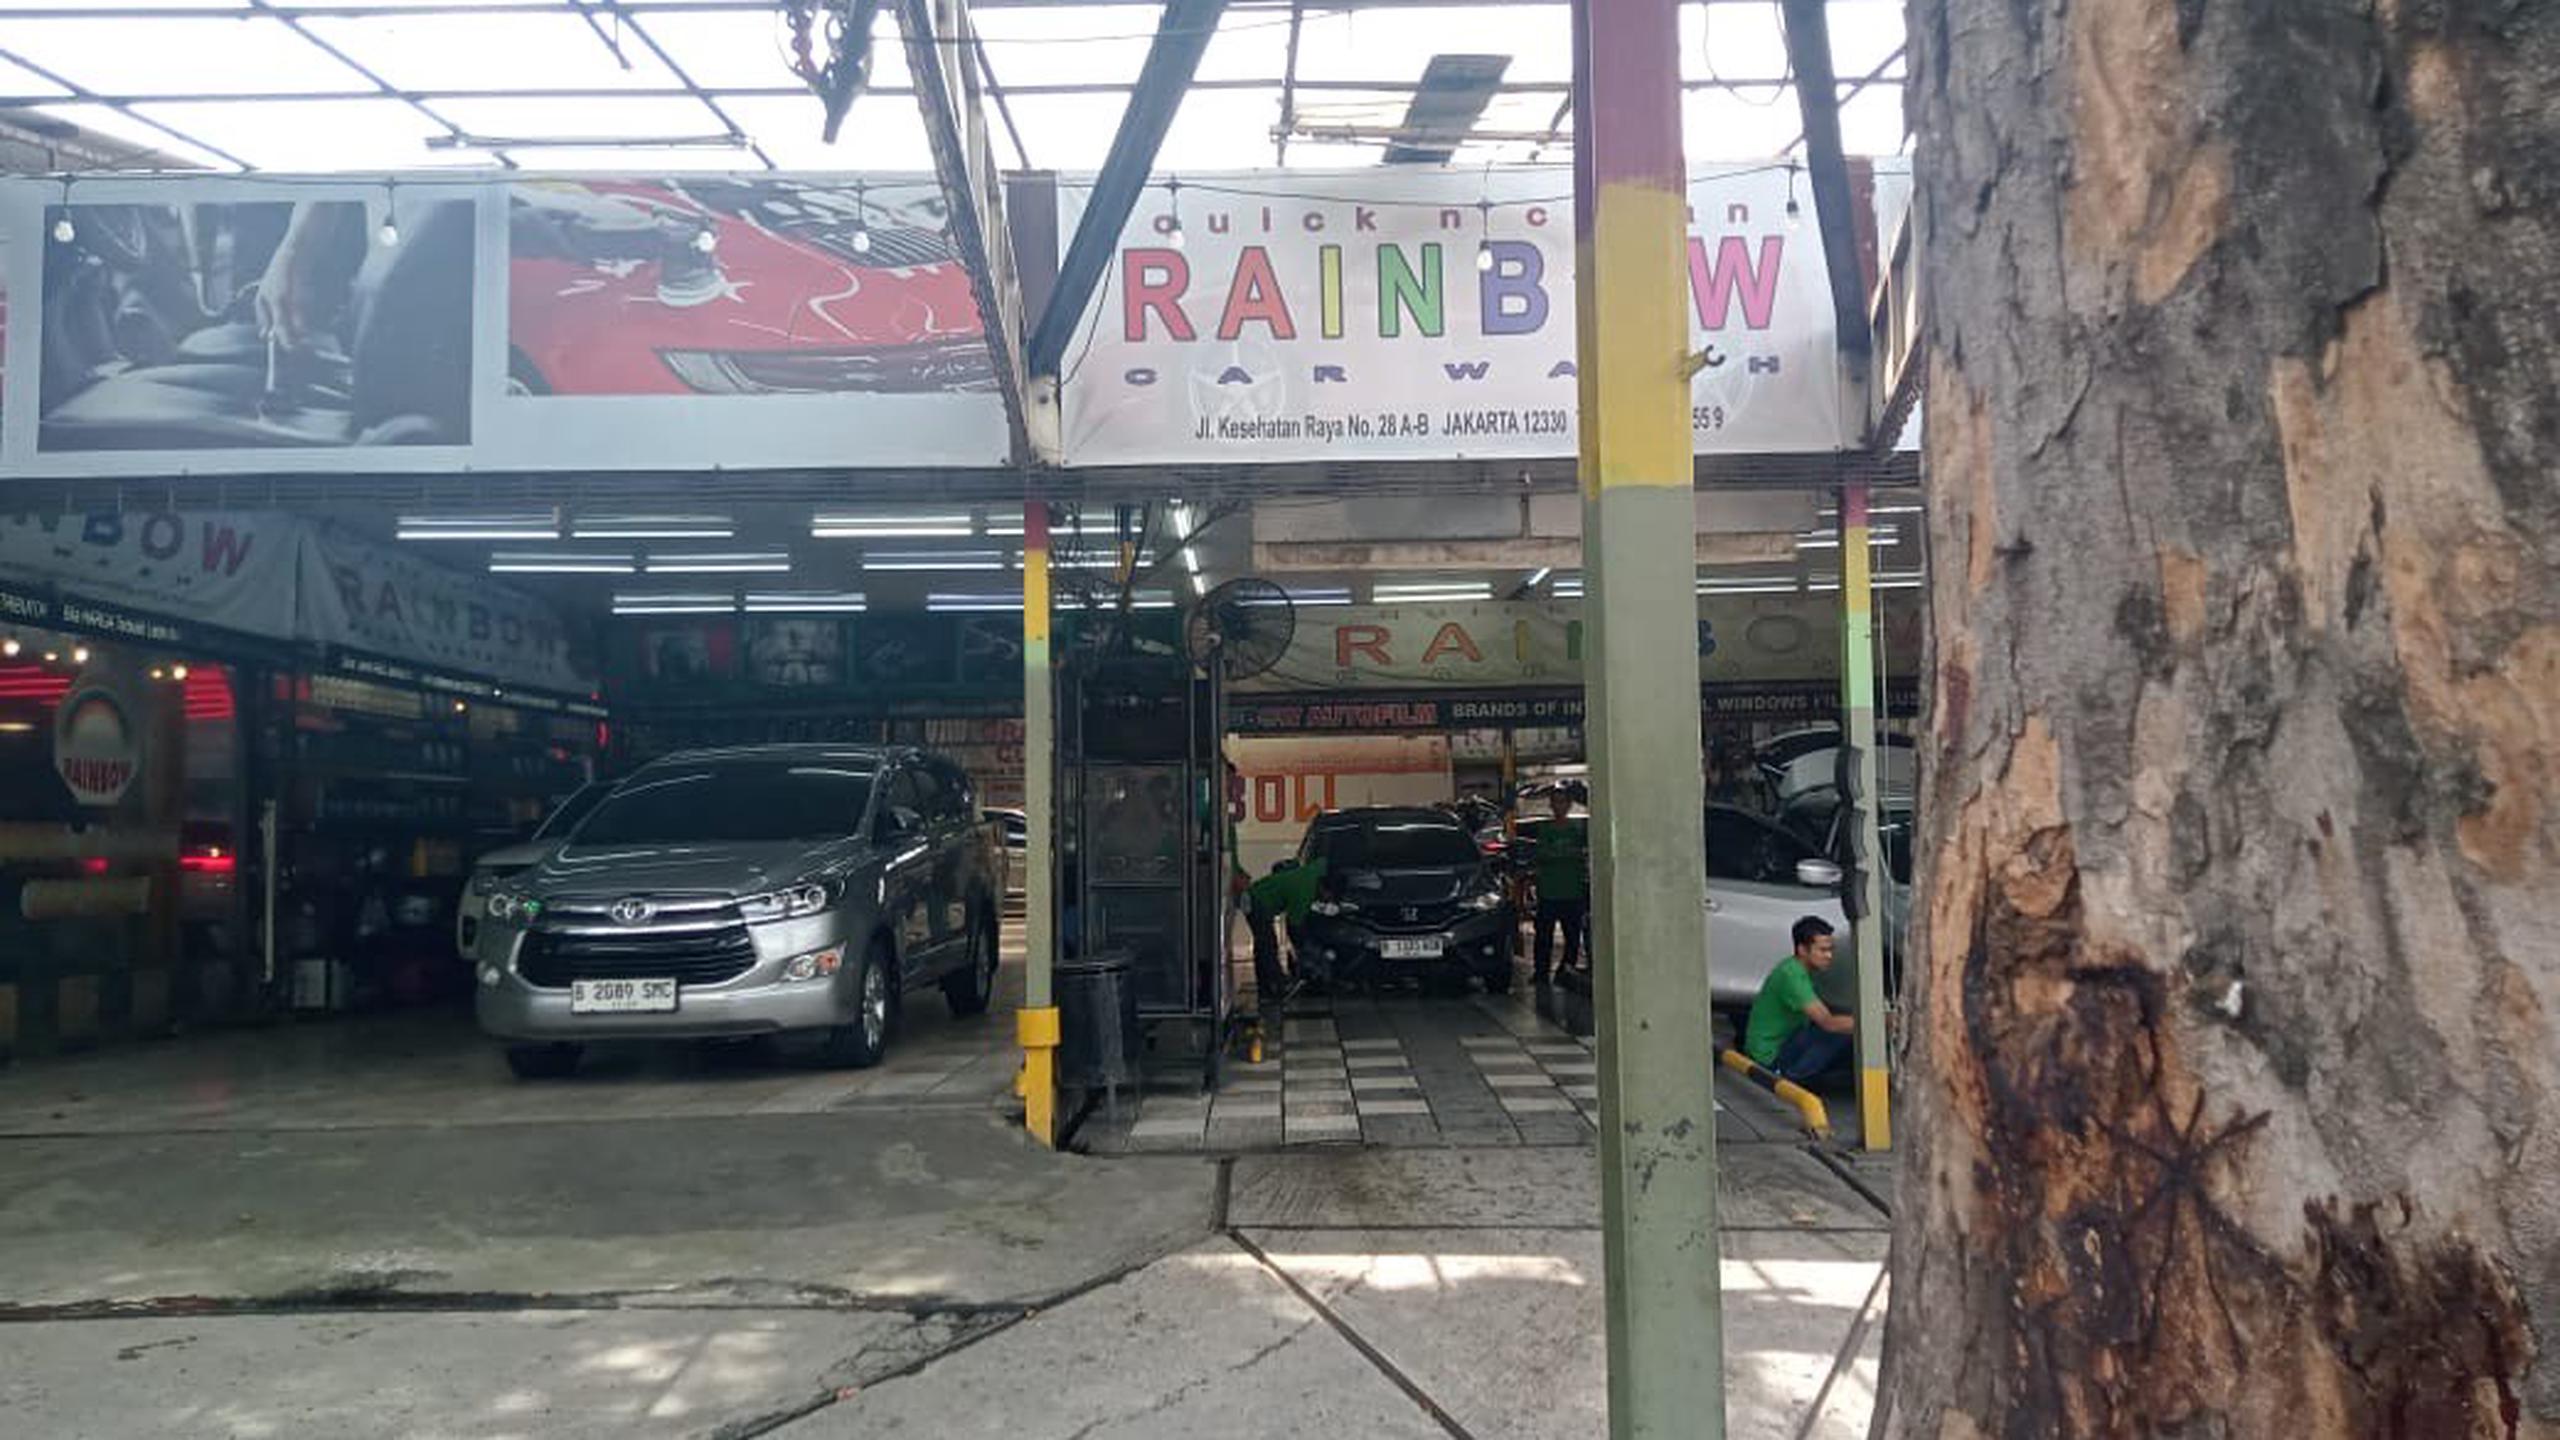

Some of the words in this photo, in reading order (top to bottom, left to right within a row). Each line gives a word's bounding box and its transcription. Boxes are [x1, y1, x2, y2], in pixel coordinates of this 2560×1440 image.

[1122, 234, 1784, 342] RAINBW
[1123, 363, 1348, 386] CAR
[1443, 355, 1781, 382] WAH
[1195, 415, 1214, 439] Jl.
[1218, 414, 1300, 439] Kesehatan
[1305, 415, 1343, 444] Raya
[1378, 413, 1397, 437] 28
[1400, 413, 1429, 437] A-B
[1442, 410, 1519, 436] JAKARTA
[1523, 409, 1567, 433] 12330
[1452, 701, 1527, 718] BRANDS
[1534, 701, 1557, 716] OF
[1717, 692, 1808, 712] WINDOWS
[593, 982, 634, 1000] 2089
